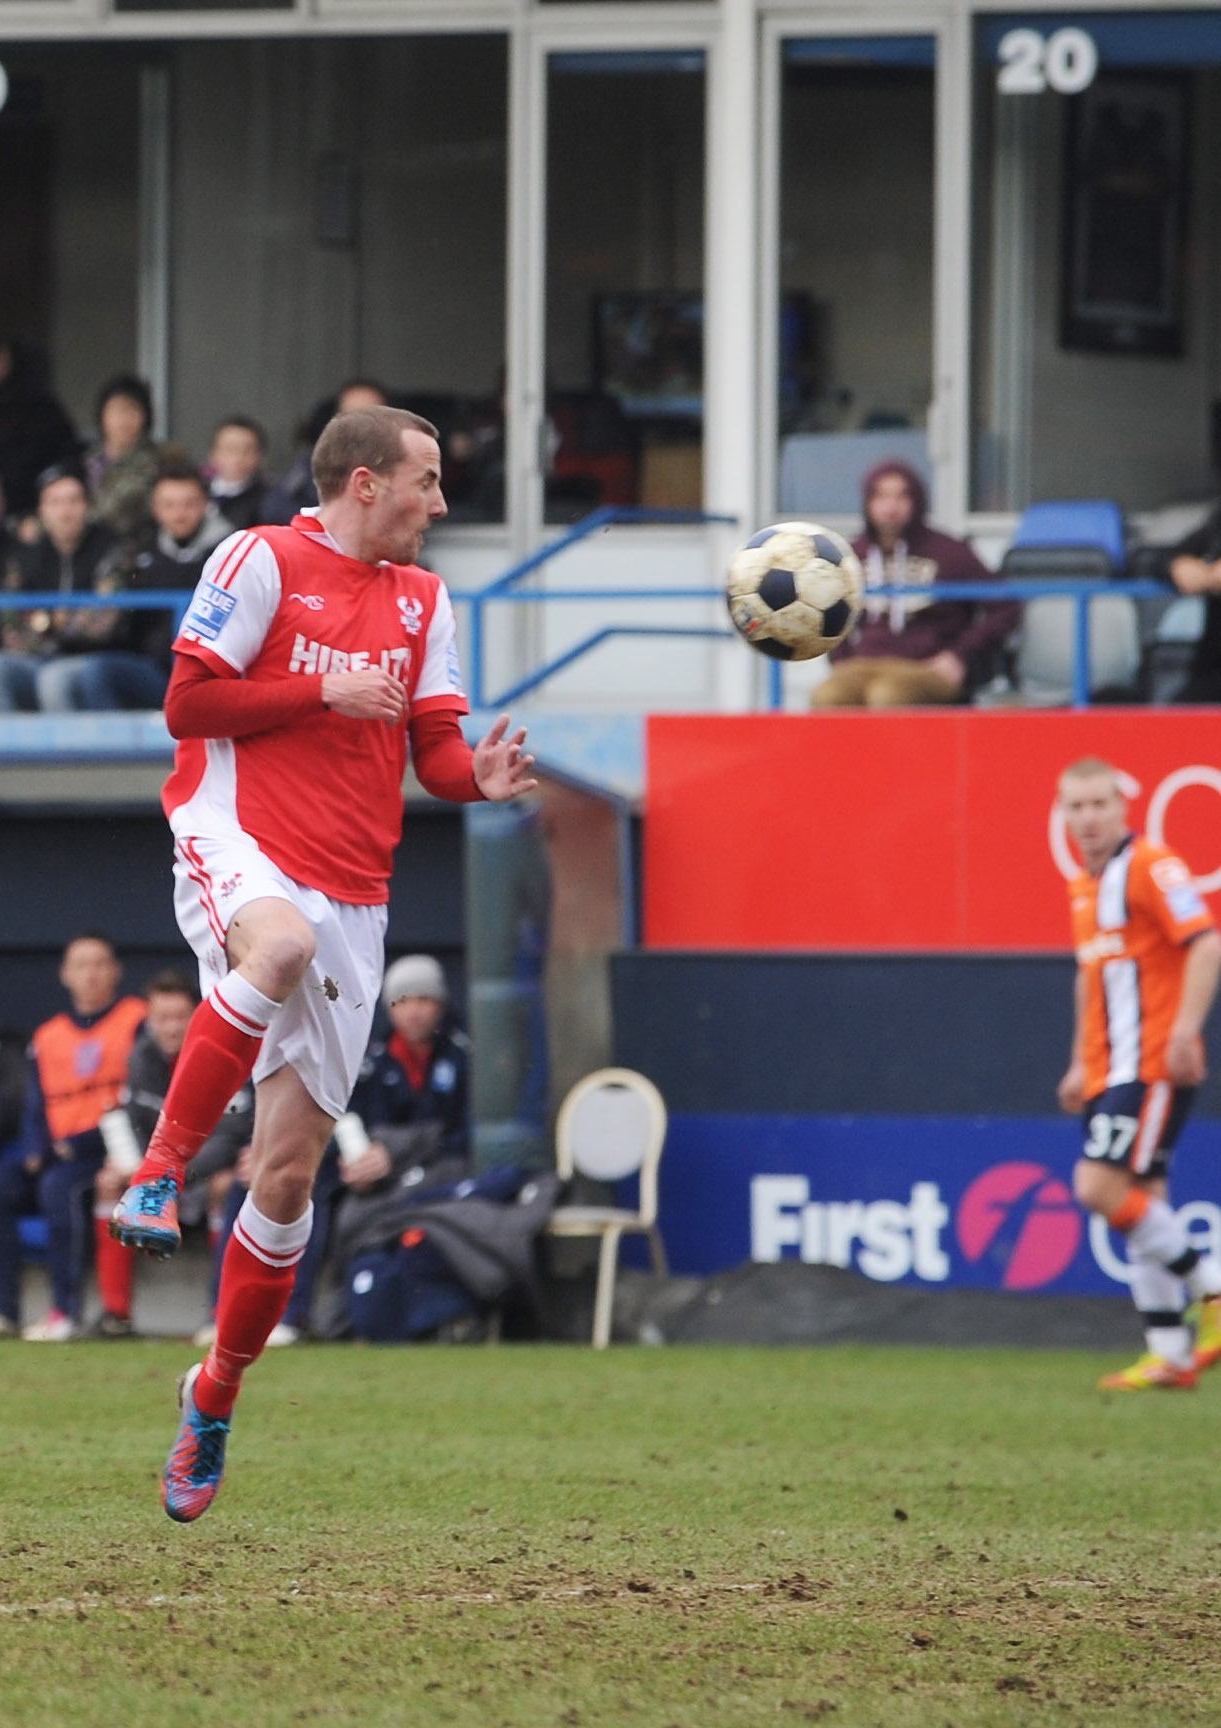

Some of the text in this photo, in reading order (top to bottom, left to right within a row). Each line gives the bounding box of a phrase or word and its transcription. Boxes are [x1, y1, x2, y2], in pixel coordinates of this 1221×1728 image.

[997, 27, 1098, 95] 20
[1084, 1113, 1138, 1160] 37
[750, 1174, 949, 1281] First
